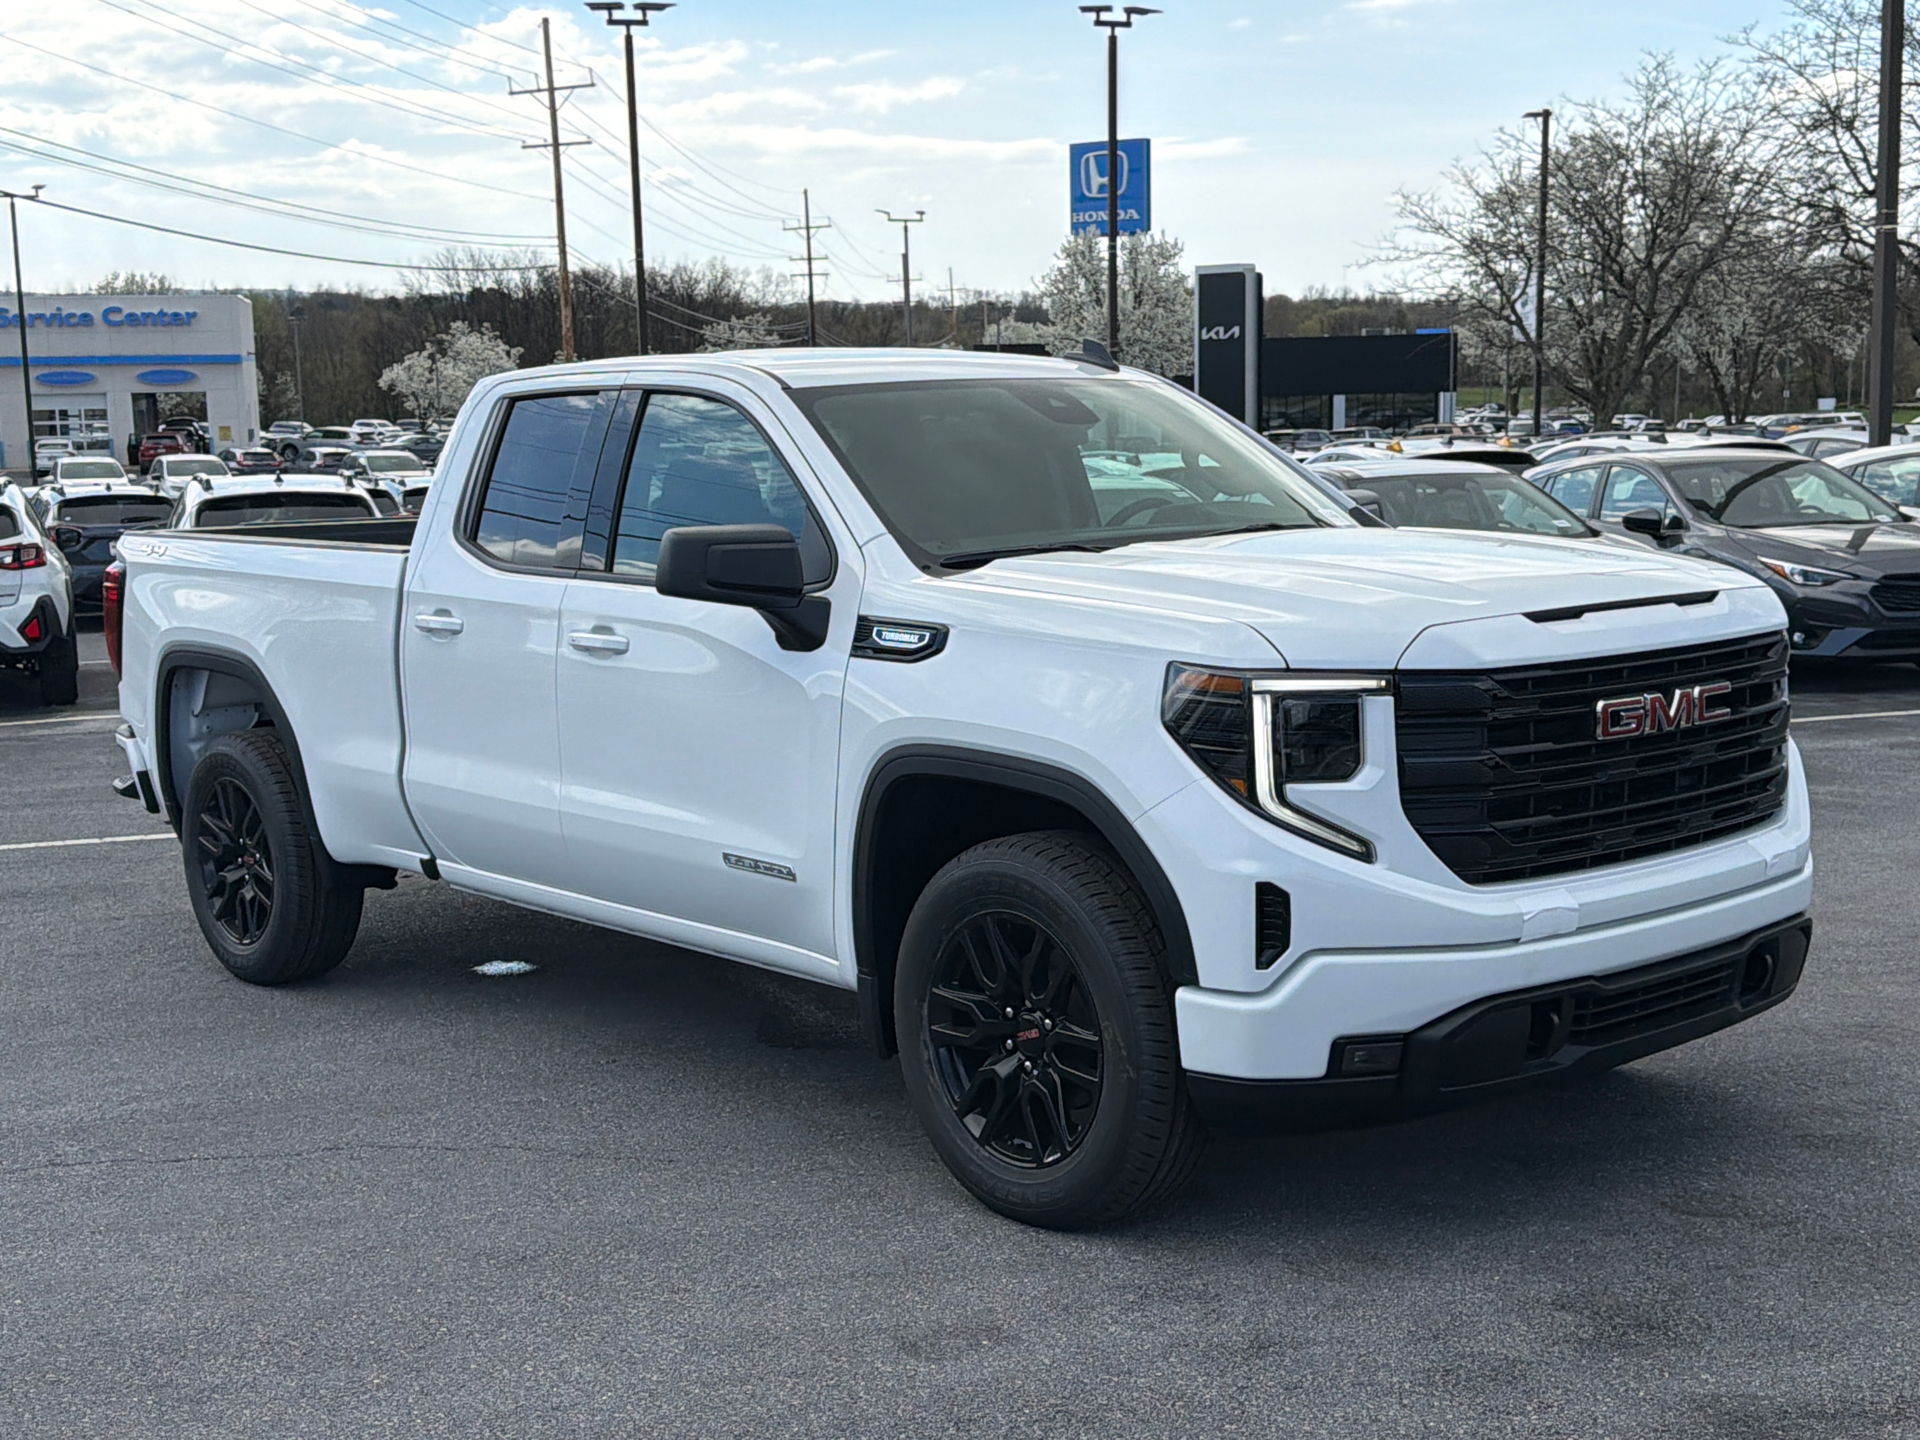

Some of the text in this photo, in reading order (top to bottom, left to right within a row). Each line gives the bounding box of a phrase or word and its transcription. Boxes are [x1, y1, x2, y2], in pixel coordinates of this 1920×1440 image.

[0, 306, 198, 328] Service Center
[1201, 325, 1240, 340] KIA
[881, 631, 920, 643] TURBOMAX
[1596, 681, 1732, 740] GMC
